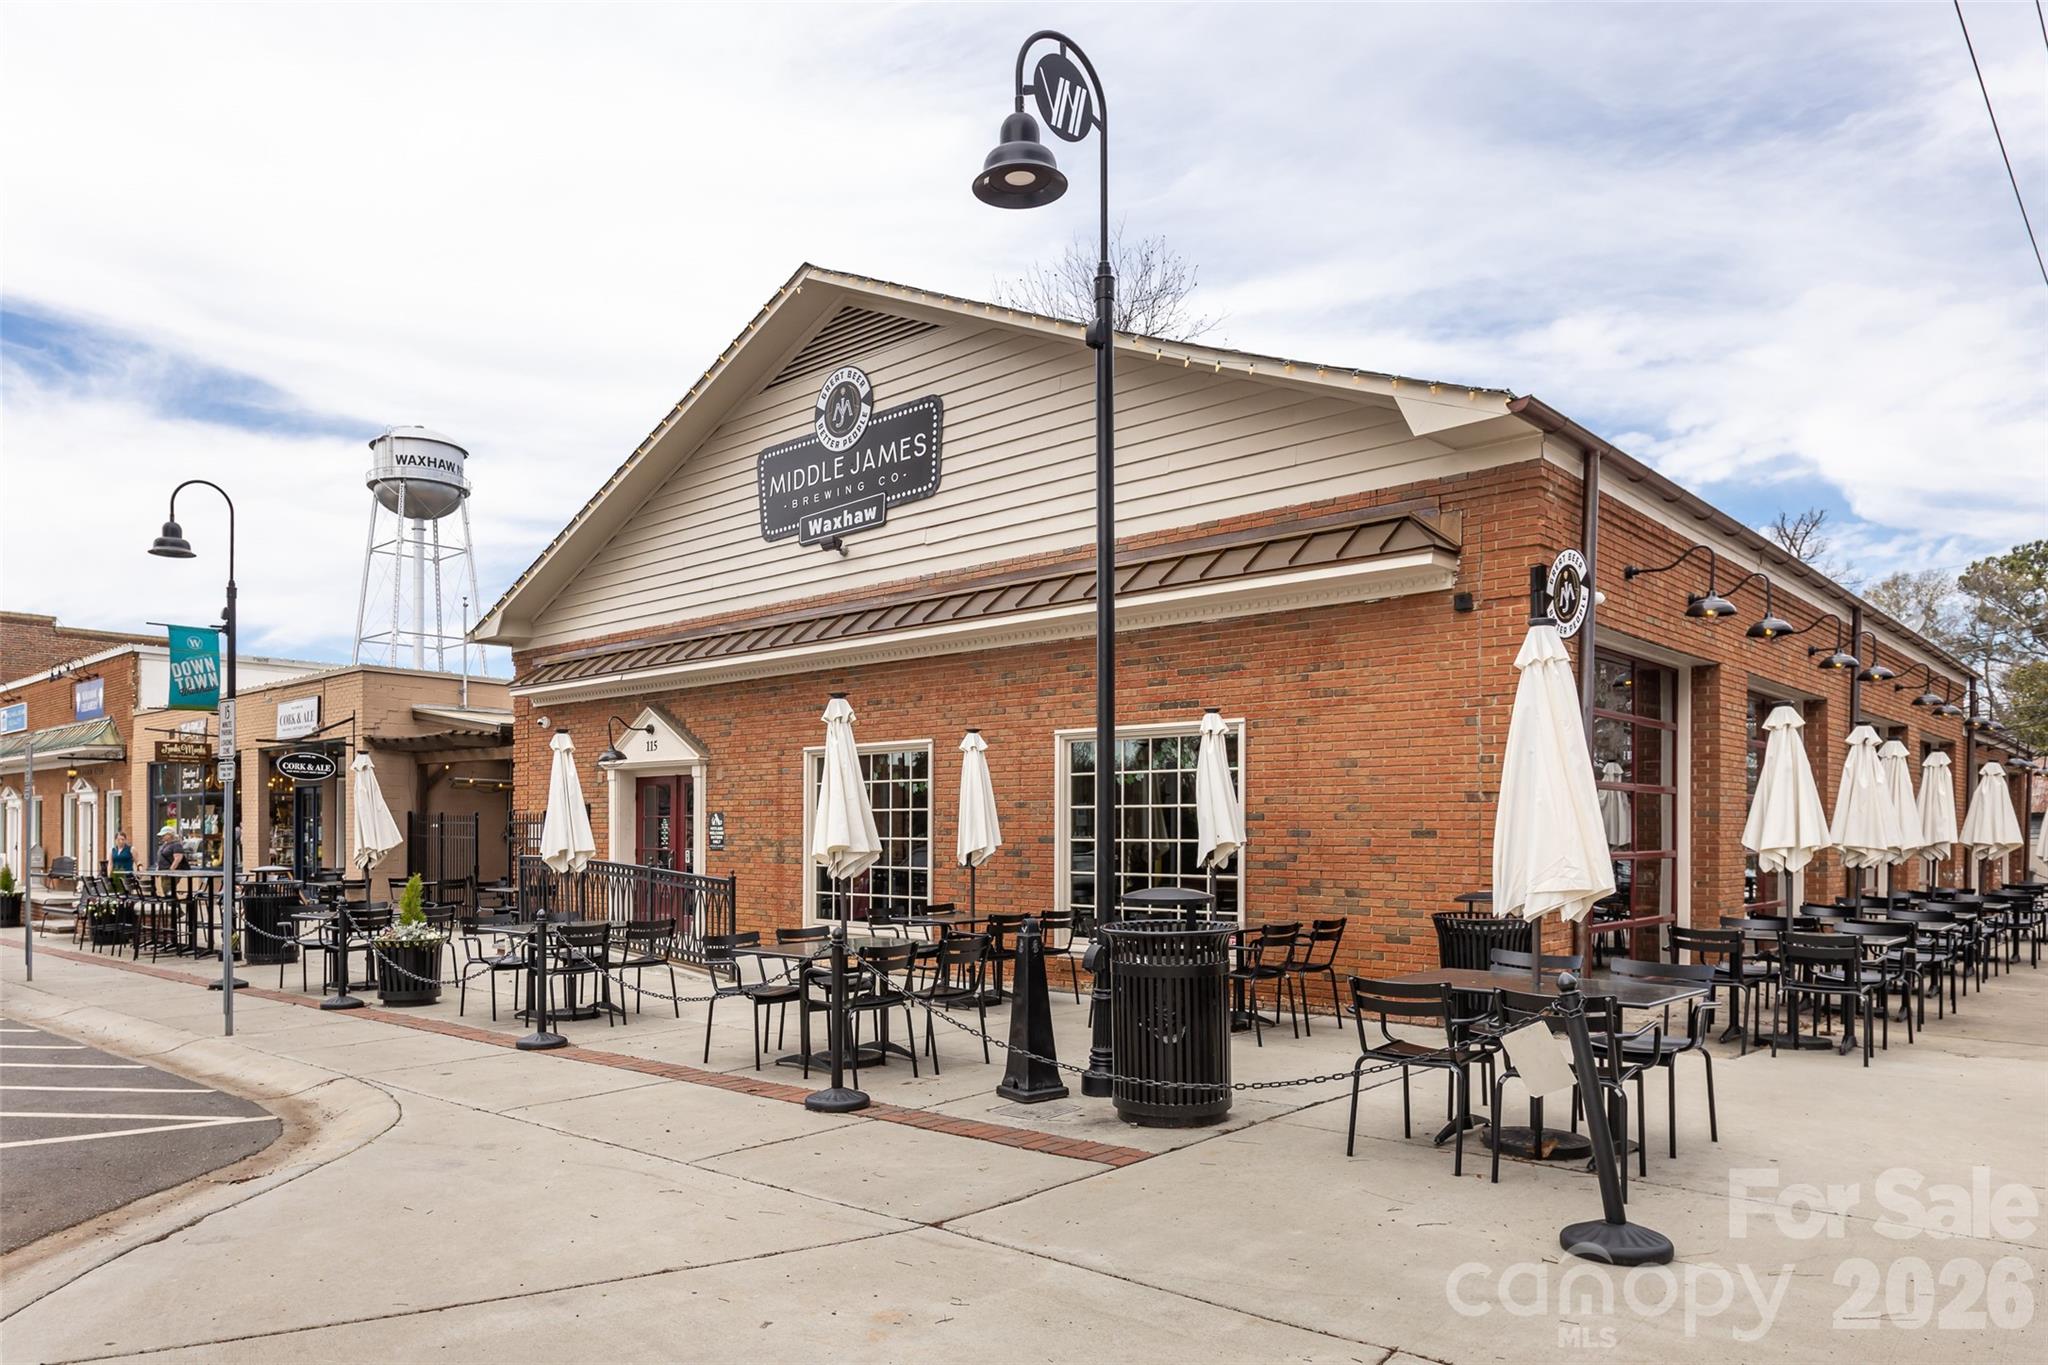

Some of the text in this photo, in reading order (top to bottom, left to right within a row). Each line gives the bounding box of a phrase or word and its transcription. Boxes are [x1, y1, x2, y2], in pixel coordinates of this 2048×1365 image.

[821, 369, 866, 400] GREAT BEER
[817, 411, 869, 449] BETTER PEOPLE
[769, 433, 928, 497] MIDDLE JAMES
[791, 482, 866, 509] BREWING
[808, 505, 878, 537] Waxhaw
[171, 657, 216, 678] DOWN
[174, 672, 219, 690] TOWN
[280, 713, 296, 726] CORK
[303, 710, 315, 722] ALE
[646, 740, 658, 752] 115
[282, 761, 306, 771] CORK
[314, 763, 332, 772] ALE
